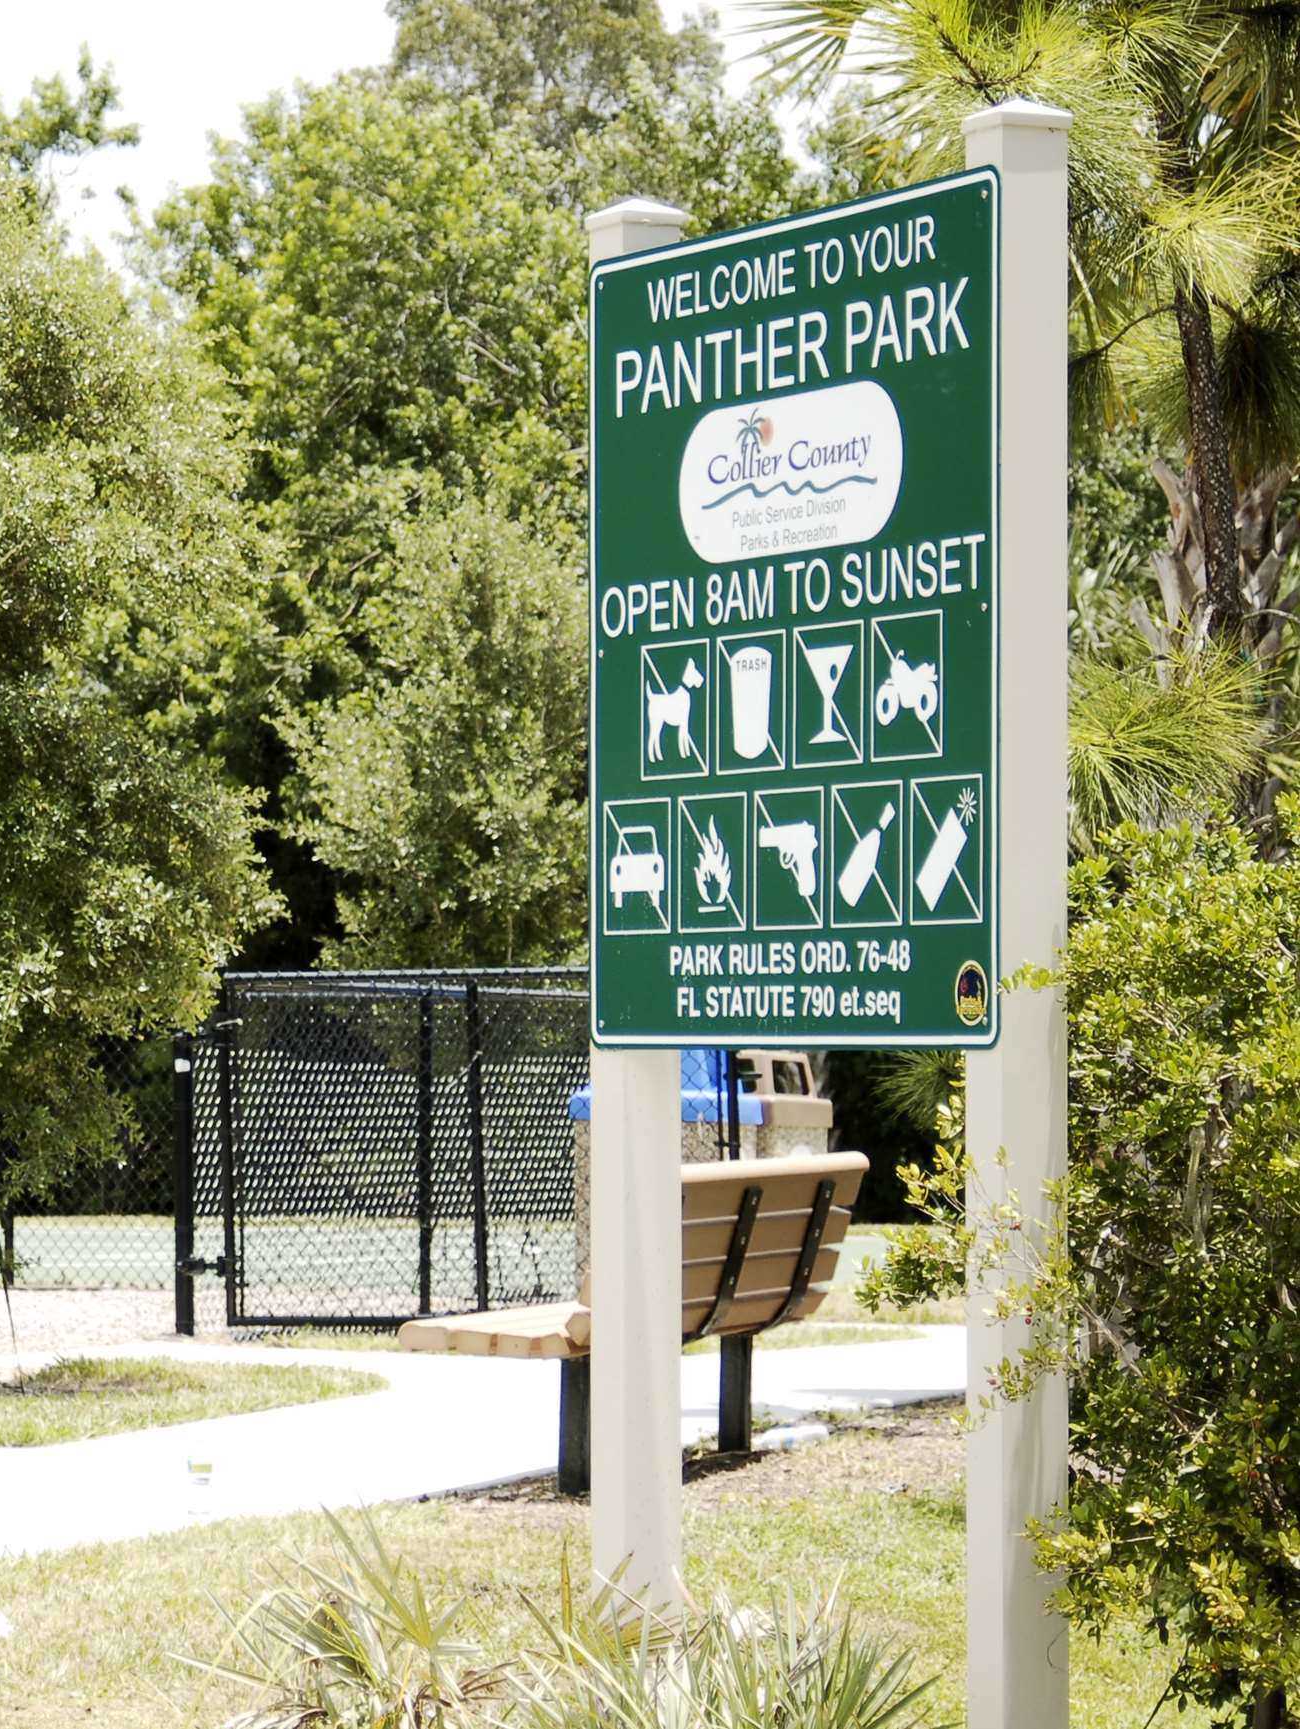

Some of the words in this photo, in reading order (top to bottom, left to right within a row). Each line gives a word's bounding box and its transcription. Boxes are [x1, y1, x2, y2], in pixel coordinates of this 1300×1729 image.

[646, 247, 796, 324] WELCOME
[803, 237, 845, 290] TO
[849, 214, 937, 279] YOUR
[615, 309, 830, 419] PANTHER
[845, 276, 971, 374] PARK
[707, 441, 782, 485] Collier
[788, 433, 872, 472] County
[732, 508, 763, 529] Public
[765, 504, 804, 524] Service
[806, 496, 846, 518] Division
[740, 532, 770, 552] Parks
[782, 523, 839, 545] Recreation
[600, 577, 695, 639] OPEN
[705, 565, 775, 627] 8AM
[784, 557, 832, 616] TO
[840, 532, 986, 609] SUNSET
[736, 656, 768, 673] TRASH
[669, 943, 725, 976] PARK
[728, 941, 797, 976] RULES
[800, 940, 852, 973] ORD.
[856, 939, 911, 972] 76-48
[676, 988, 701, 1018] FL
[705, 985, 796, 1018] STATUTE
[801, 985, 836, 1018] 790
[839, 989, 901, 1025] et.seq
